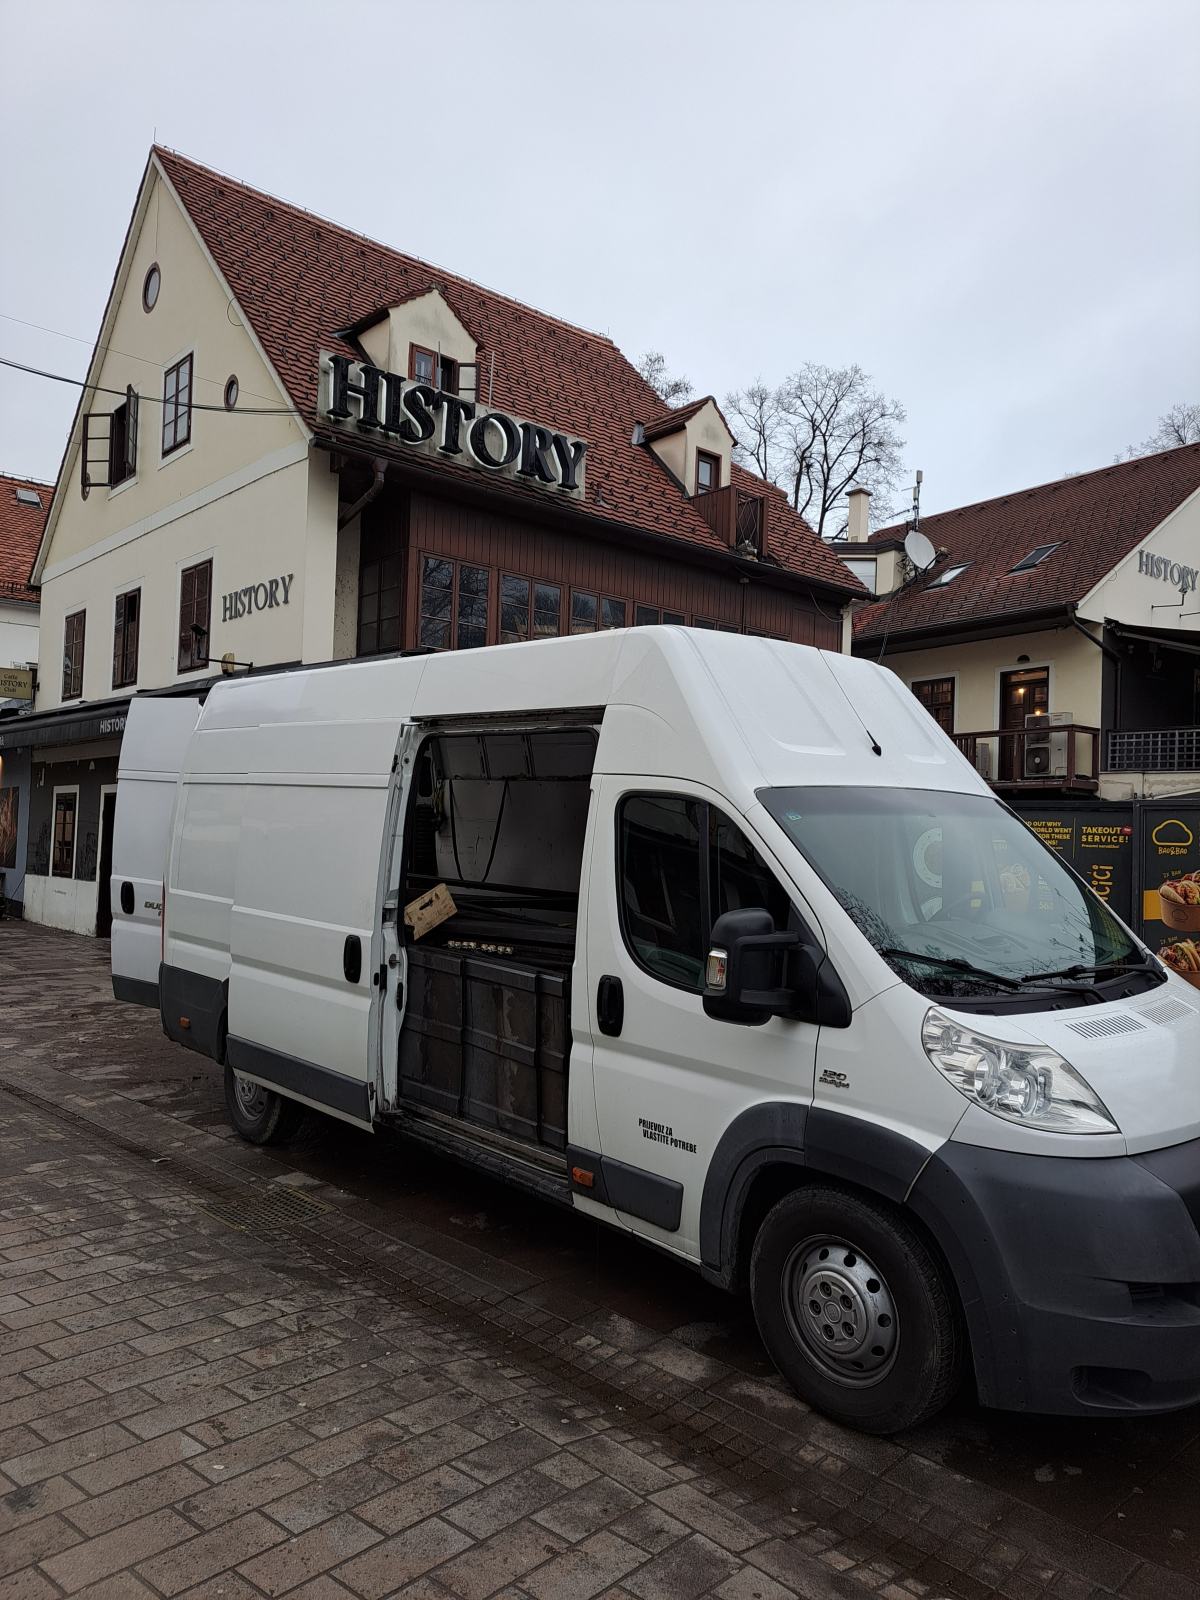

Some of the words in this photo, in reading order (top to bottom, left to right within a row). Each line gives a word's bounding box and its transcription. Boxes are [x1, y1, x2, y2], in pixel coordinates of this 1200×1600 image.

[327, 354, 589, 491] HISTORY
[1138, 549, 1199, 592] HISTORY
[222, 574, 294, 622] HISTORY
[0, 679, 28, 689] ISTORY
[99, 717, 128, 734] HISTOR
[1081, 826, 1122, 834] TAKEOUT
[1081, 835, 1129, 843] SERVICE!
[638, 1118, 665, 1135] PRIJEVOZ
[665, 1126, 673, 1137] ZA
[642, 1129, 670, 1145] VLASTITE
[670, 1137, 697, 1154] POTREBE
